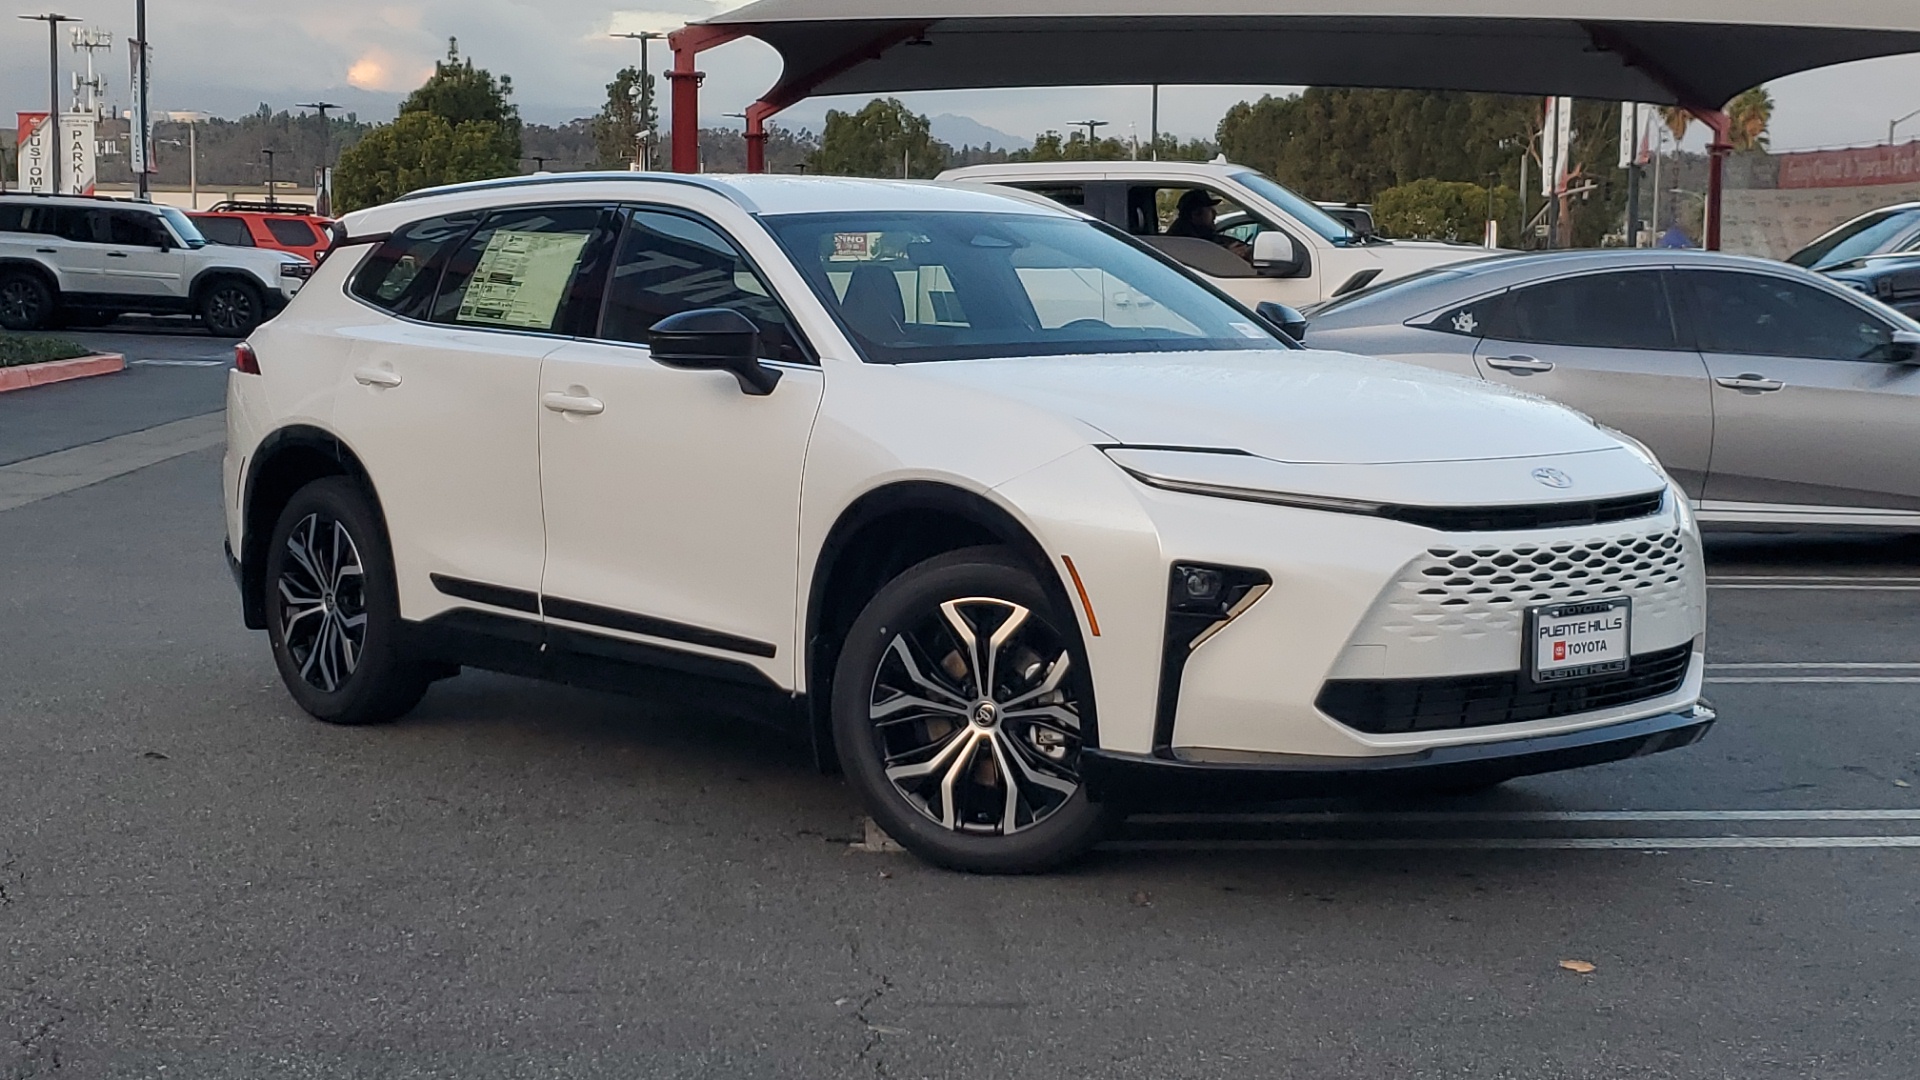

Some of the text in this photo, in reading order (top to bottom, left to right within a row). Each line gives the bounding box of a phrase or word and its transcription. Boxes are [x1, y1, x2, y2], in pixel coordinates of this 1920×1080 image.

[1561, 603, 1608, 616] TOYOTA
[1540, 617, 1622, 639] PUENTE HILLS
[1567, 639, 1608, 656] TOYOTA
[1540, 660, 1624, 681] PUENTE HILLS
